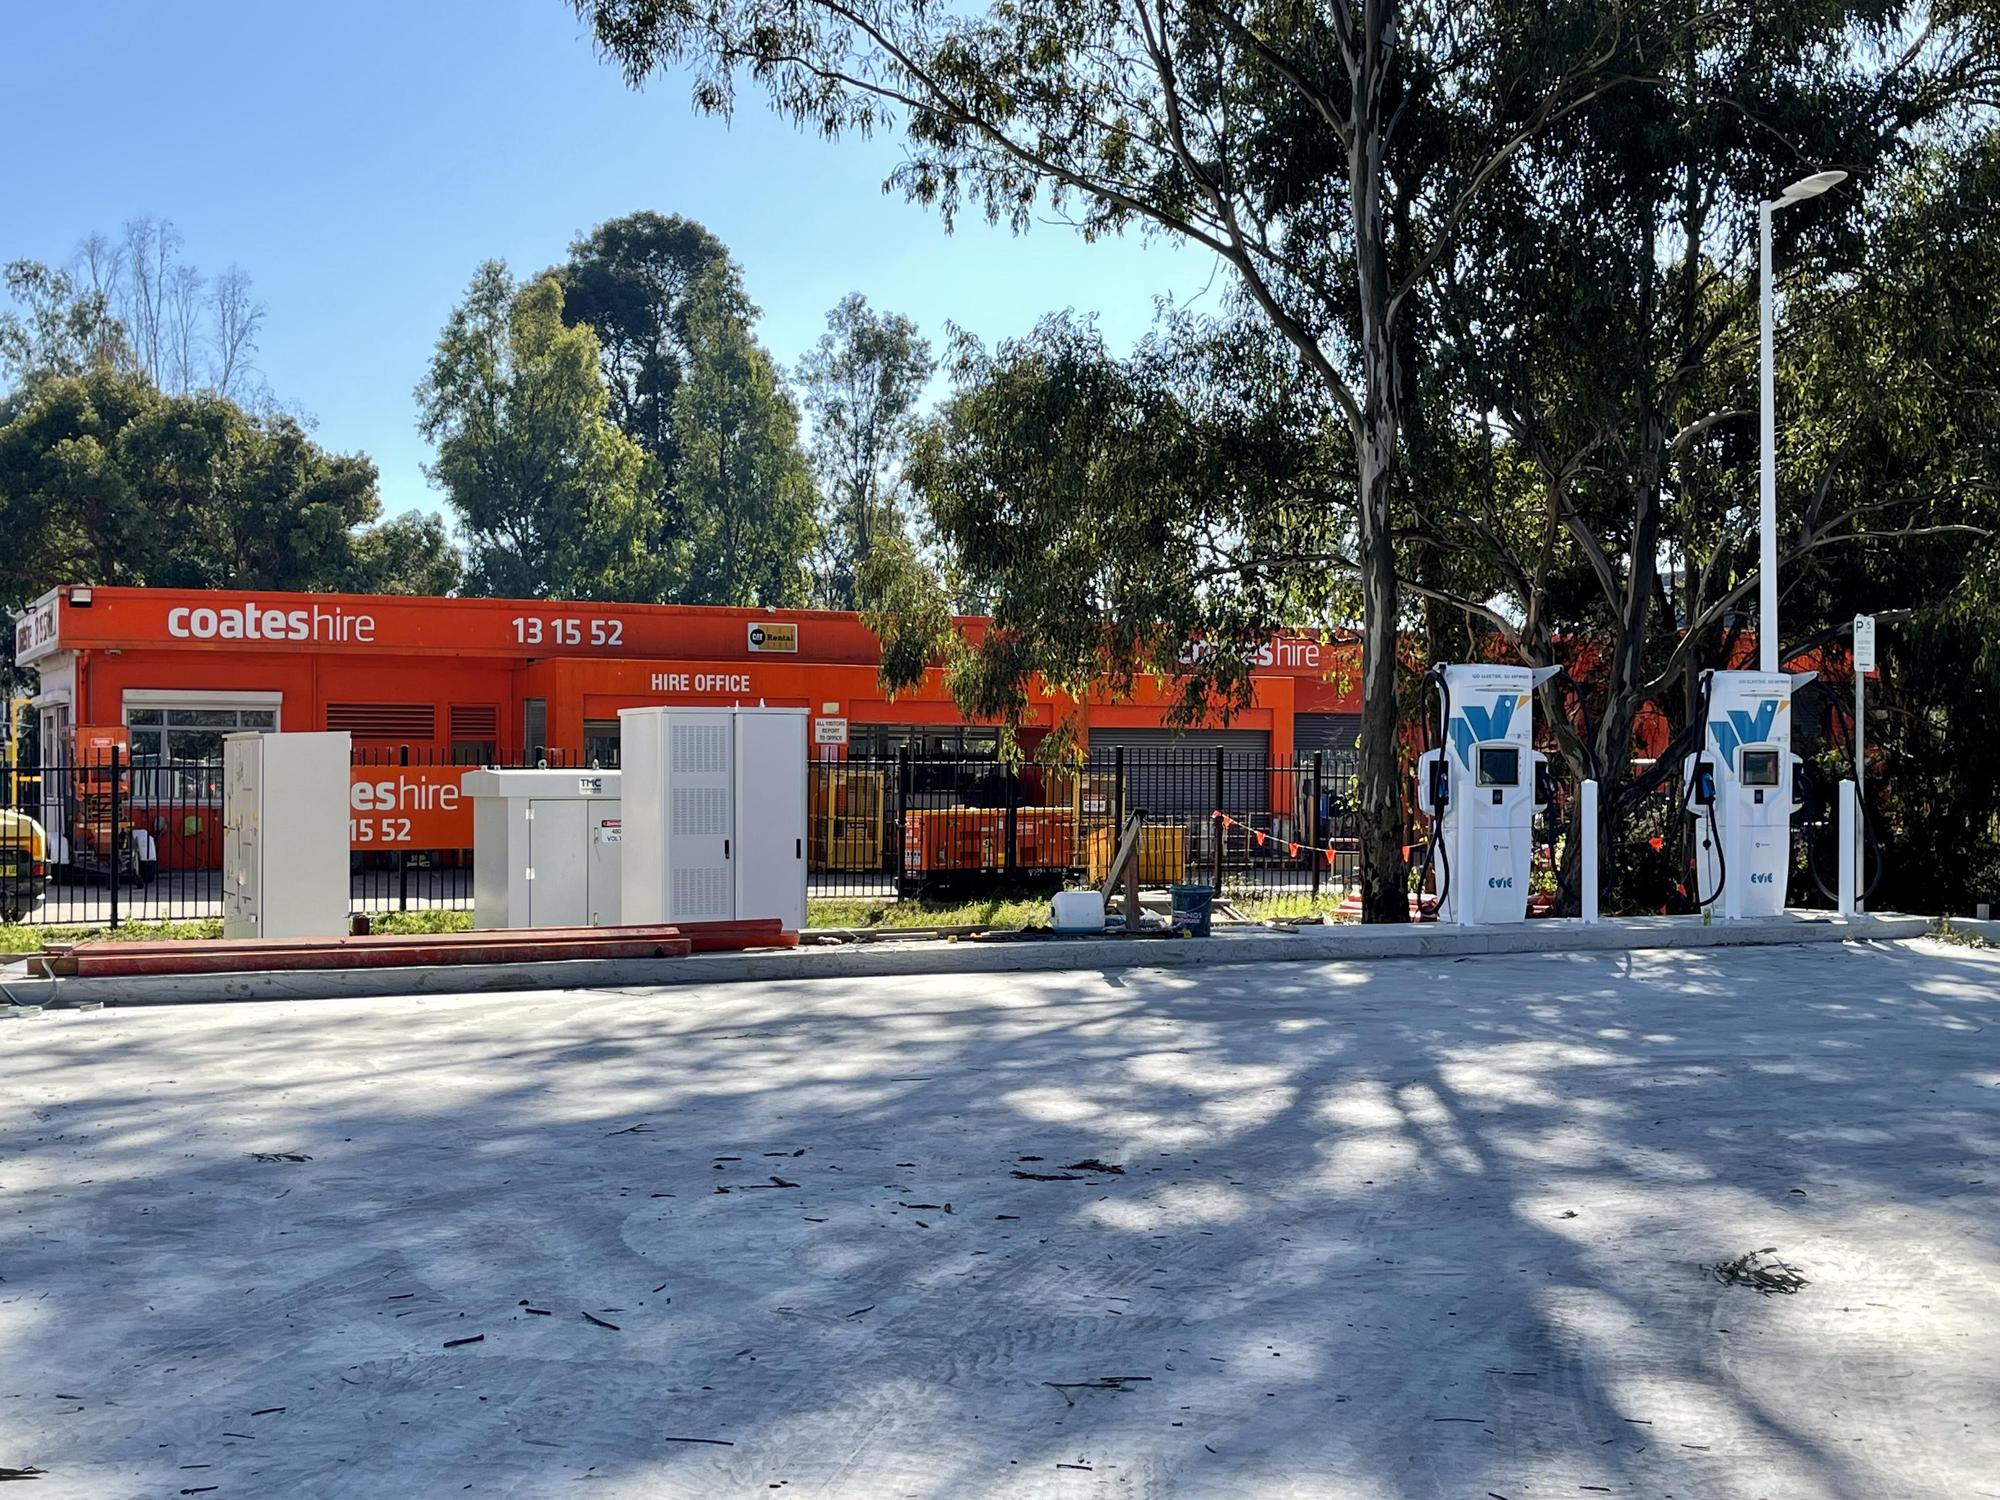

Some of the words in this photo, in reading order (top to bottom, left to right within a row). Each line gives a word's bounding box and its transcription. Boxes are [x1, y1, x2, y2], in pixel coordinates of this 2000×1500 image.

[512, 617, 543, 644] 13
[551, 618, 581, 645] 15
[591, 619, 623, 645] 52
[1856, 621, 1864, 633] P
[752, 632, 764, 641] CAT
[767, 633, 794, 642] Rental
[651, 673, 690, 691] HIRE
[694, 674, 750, 692] OFFICE
[580, 778, 602, 787] TMC
[351, 775, 459, 810] eshire
[350, 818, 374, 841] 15
[381, 818, 411, 841] 52
